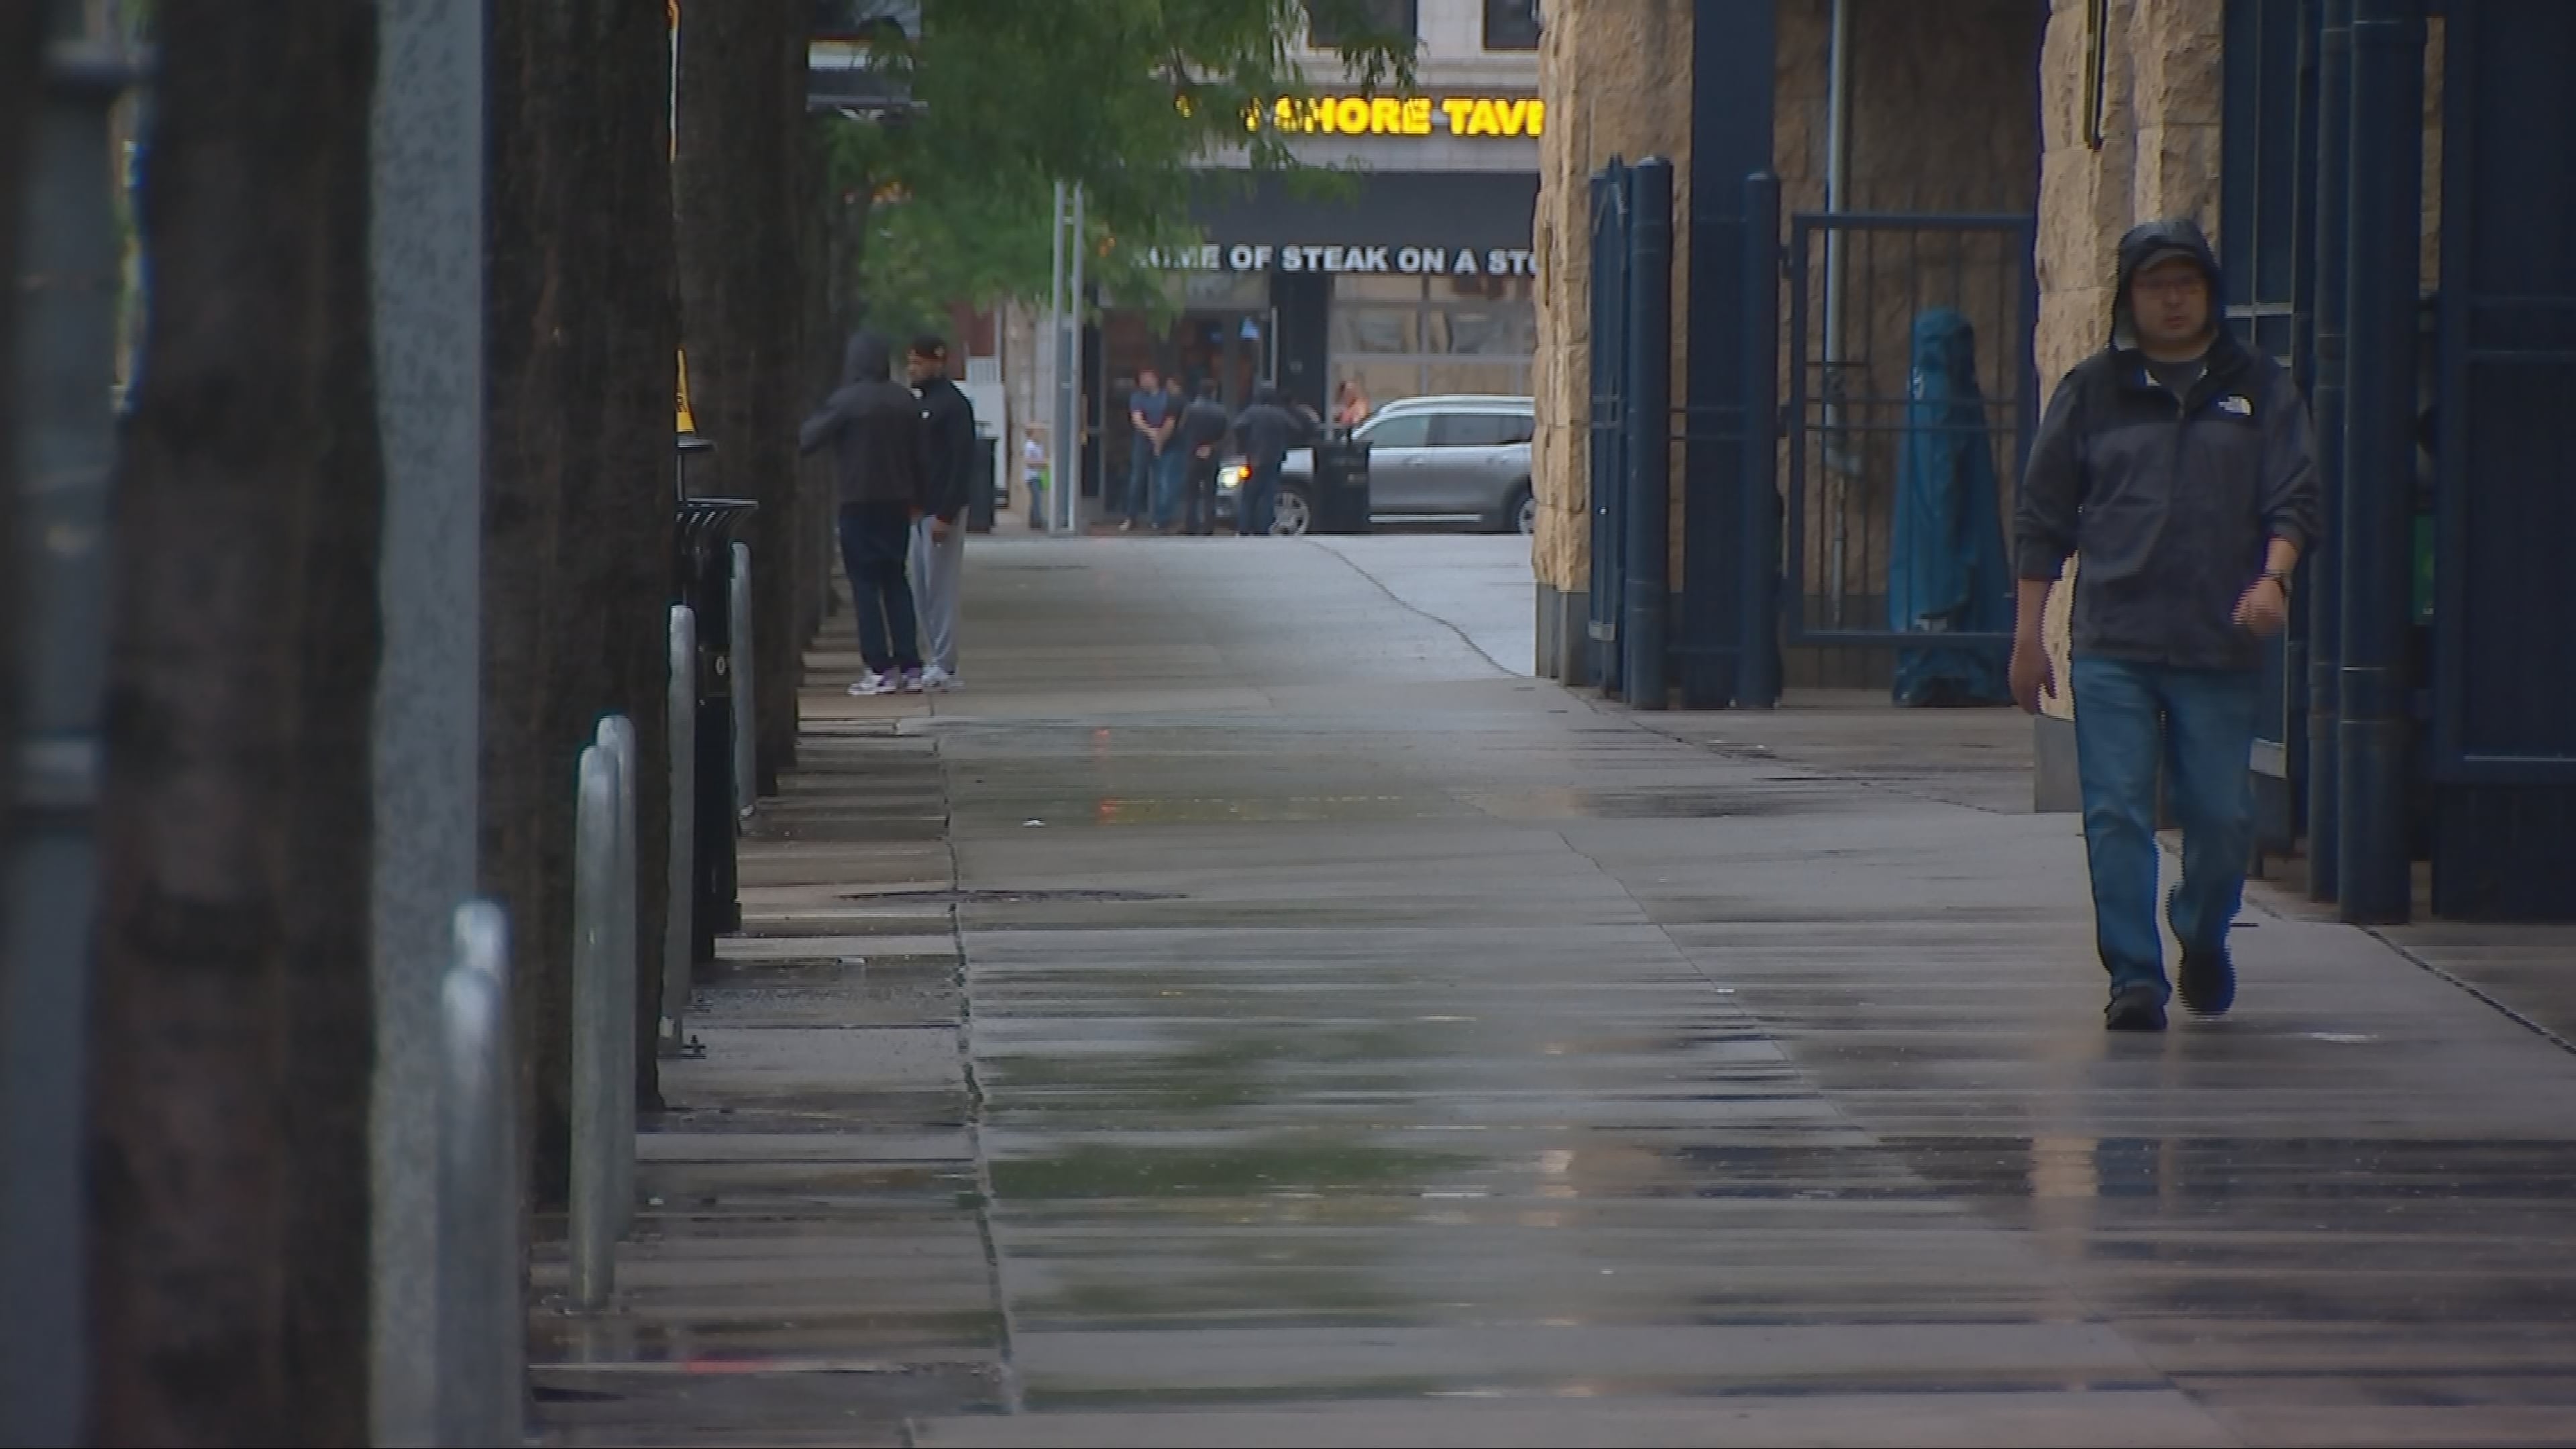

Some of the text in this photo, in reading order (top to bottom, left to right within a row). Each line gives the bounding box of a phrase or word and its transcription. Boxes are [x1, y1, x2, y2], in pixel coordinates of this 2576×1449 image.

[1229, 244, 1273, 270] OF
[1282, 246, 1388, 272] STEAK
[1397, 247, 1445, 273] ON
[1454, 248, 1477, 274] A
